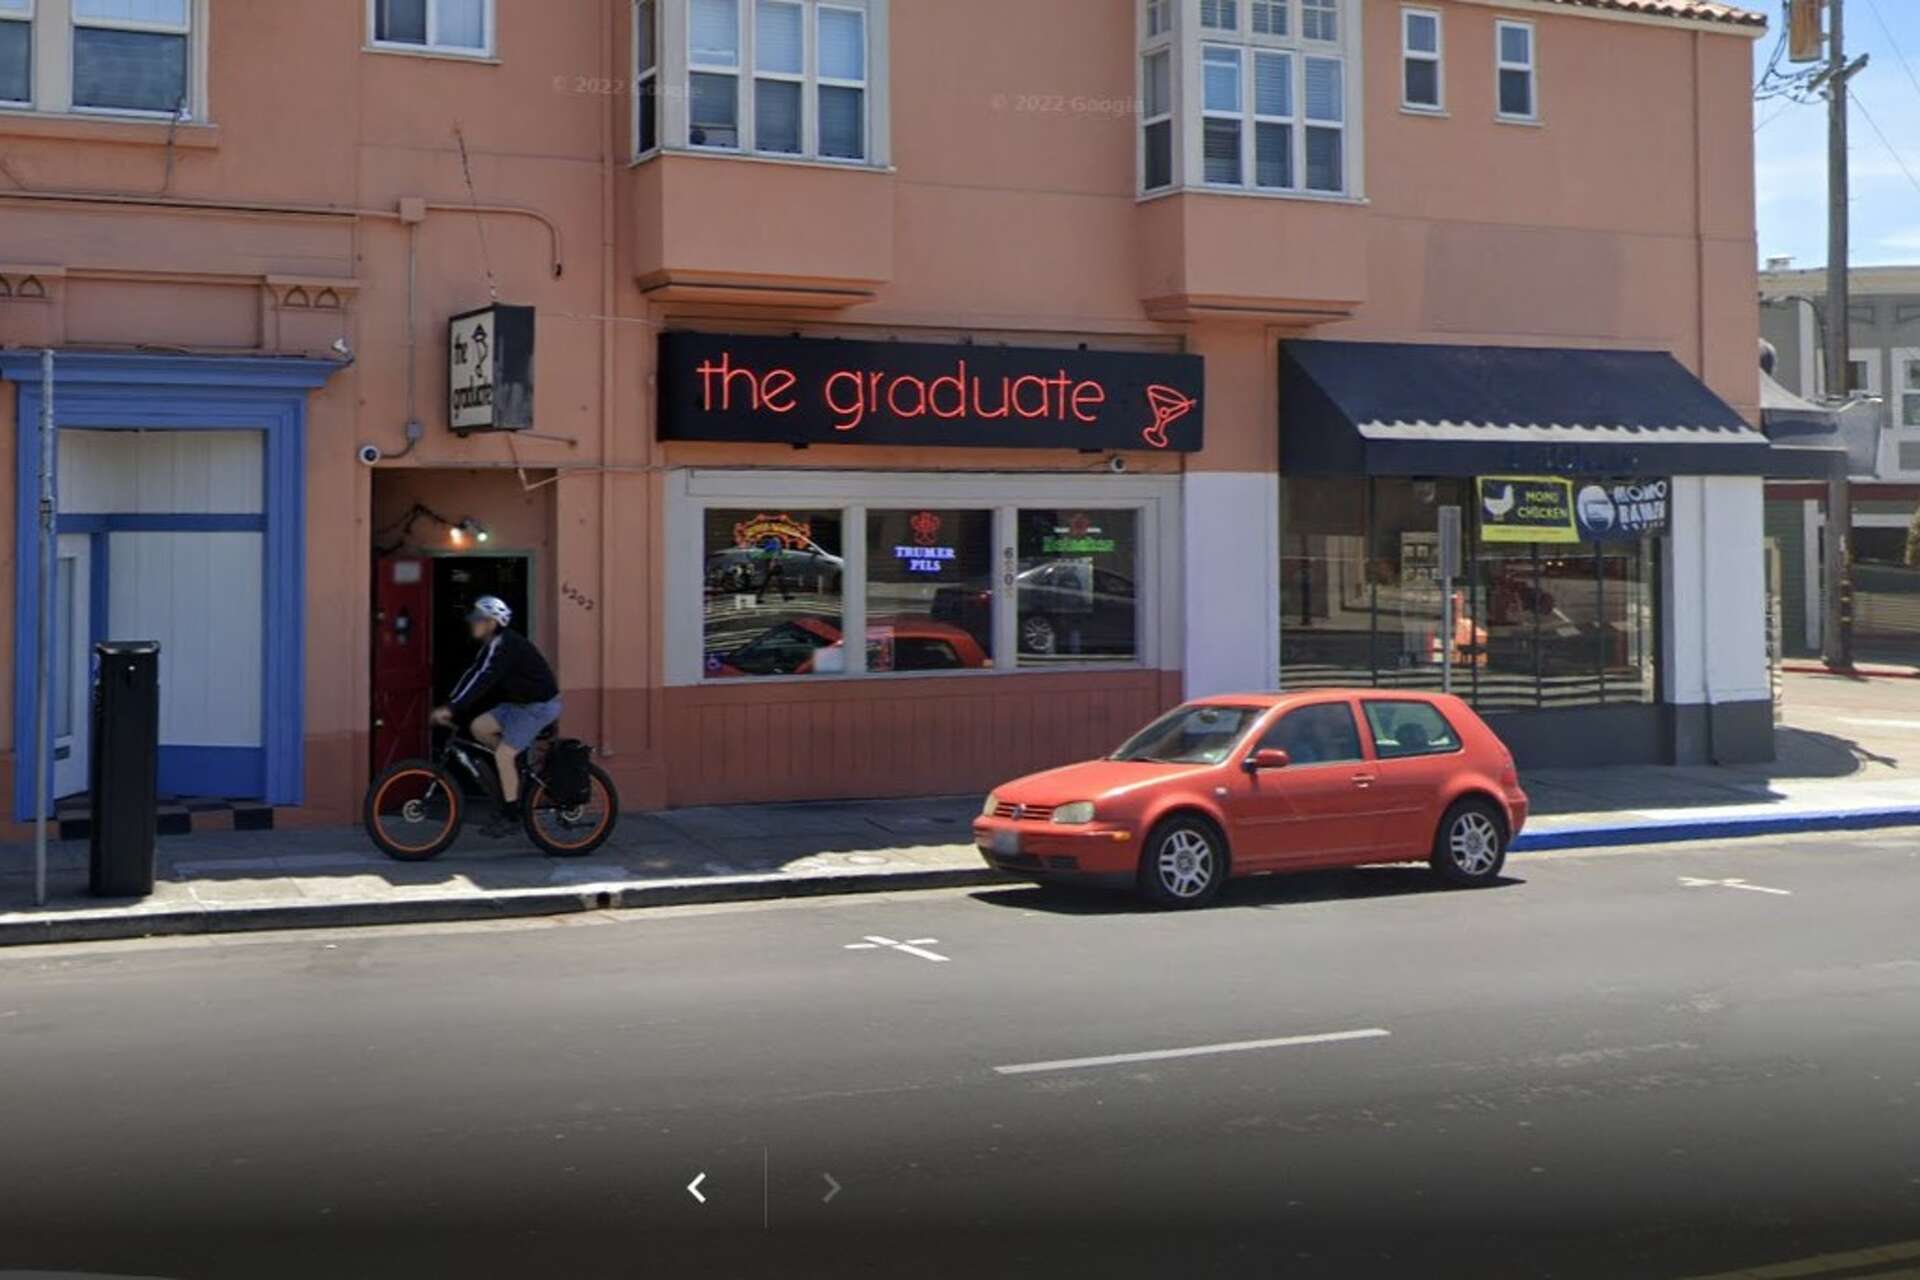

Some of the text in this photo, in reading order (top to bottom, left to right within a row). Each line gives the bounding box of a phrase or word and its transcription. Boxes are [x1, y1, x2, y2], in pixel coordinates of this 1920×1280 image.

[696, 352, 1104, 430] the graduate
[1517, 506, 1568, 519] CHICKEN
[894, 546, 956, 559] TRUMER
[909, 559, 941, 571] PILS
